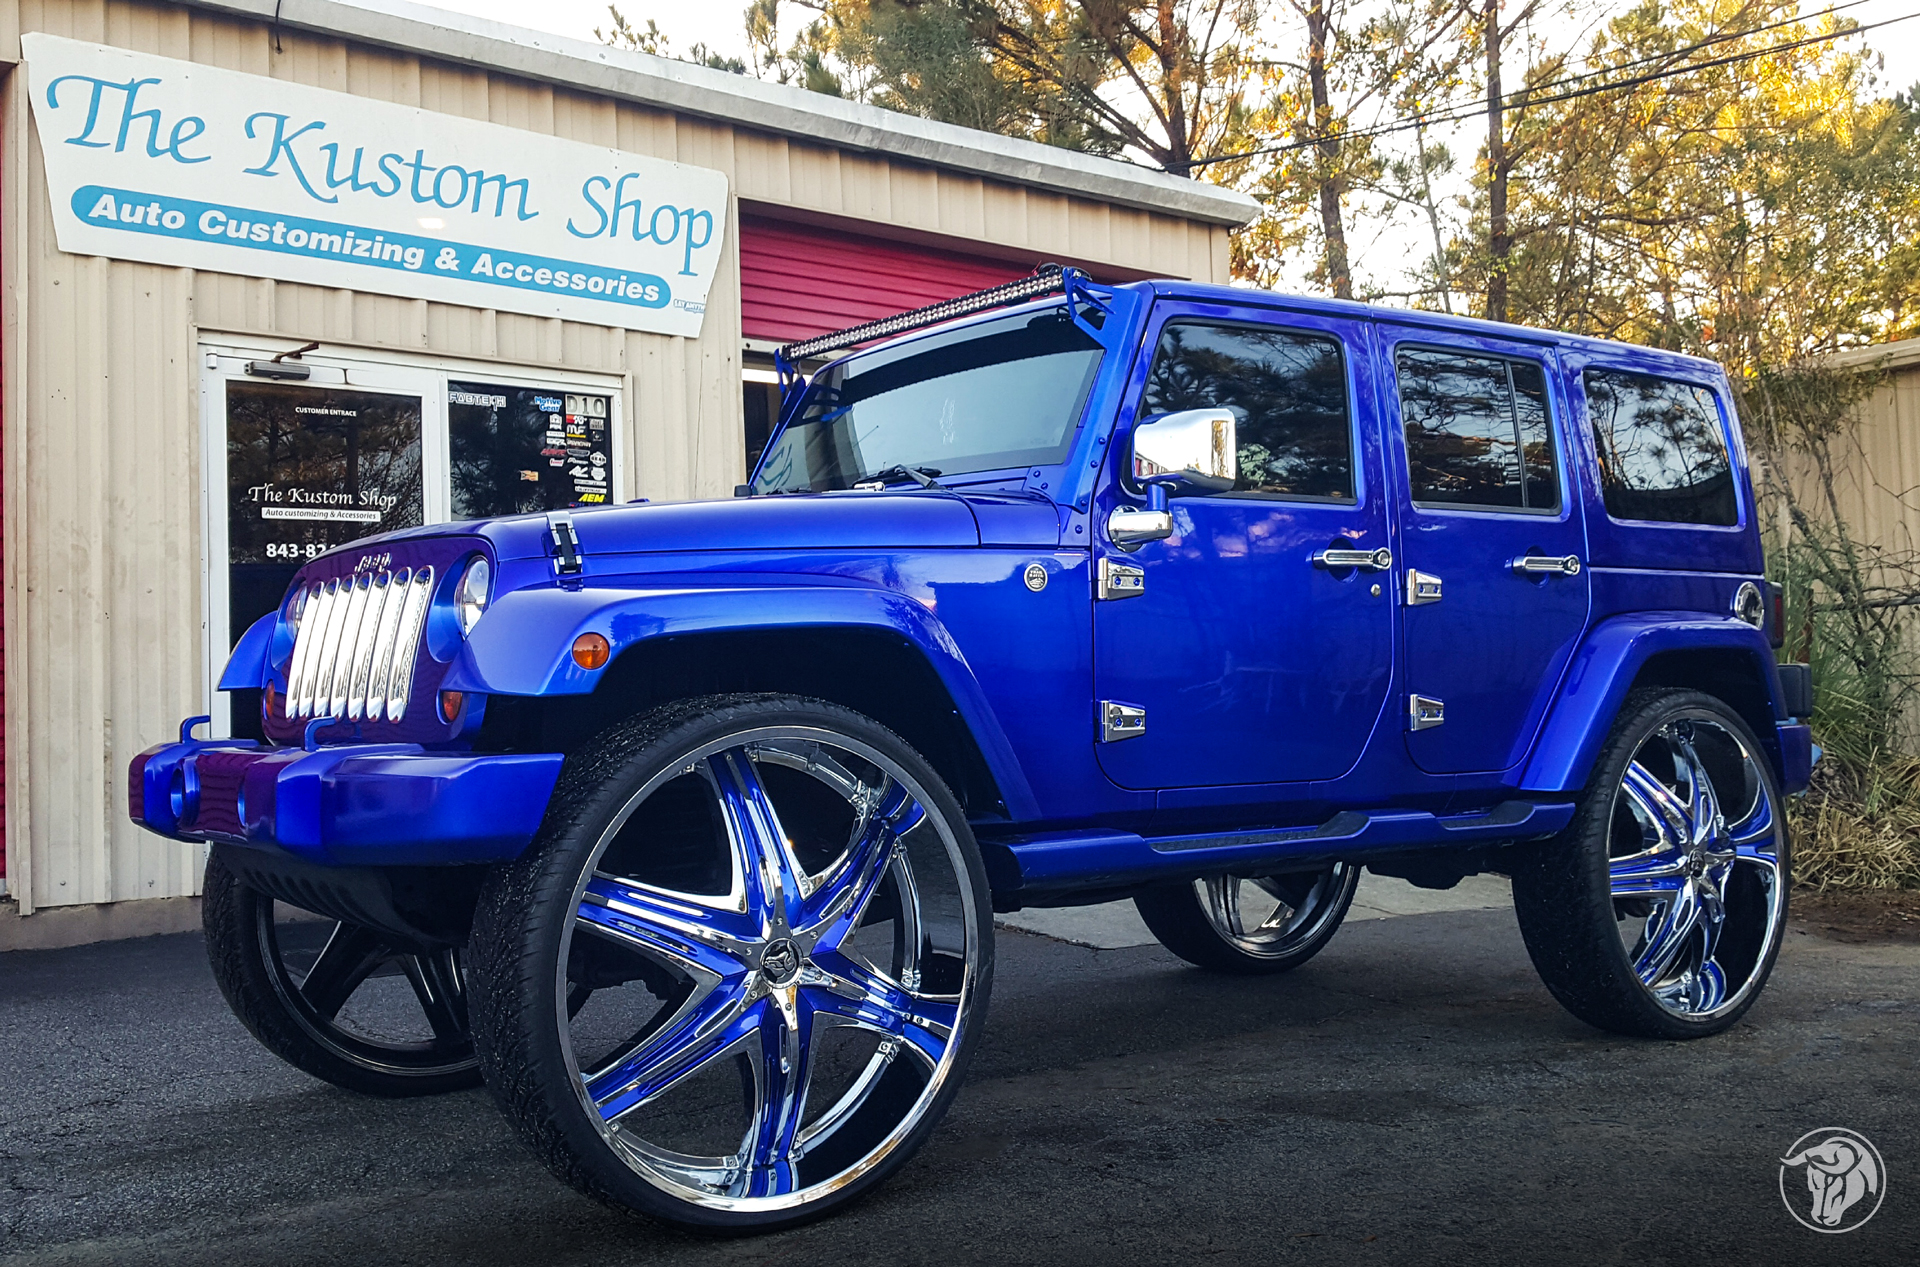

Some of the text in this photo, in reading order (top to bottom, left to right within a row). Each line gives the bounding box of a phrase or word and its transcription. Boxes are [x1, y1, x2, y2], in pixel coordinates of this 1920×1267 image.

[46, 75, 713, 276] The Kustom Shop
[88, 194, 660, 302] Auto Customizing & Accessories
[449, 392, 507, 408] FABTECH
[534, 396, 562, 406] Motive
[295, 406, 357, 417] CUSTOMER ENTRACE
[539, 403, 560, 412] Gear
[248, 483, 397, 513] The Kustom Shop
[578, 493, 606, 503] AEM
[265, 508, 284, 517] Auto
[284, 510, 329, 519] customizing
[336, 511, 377, 520] Accessories
[266, 543, 337, 558] 843-82
